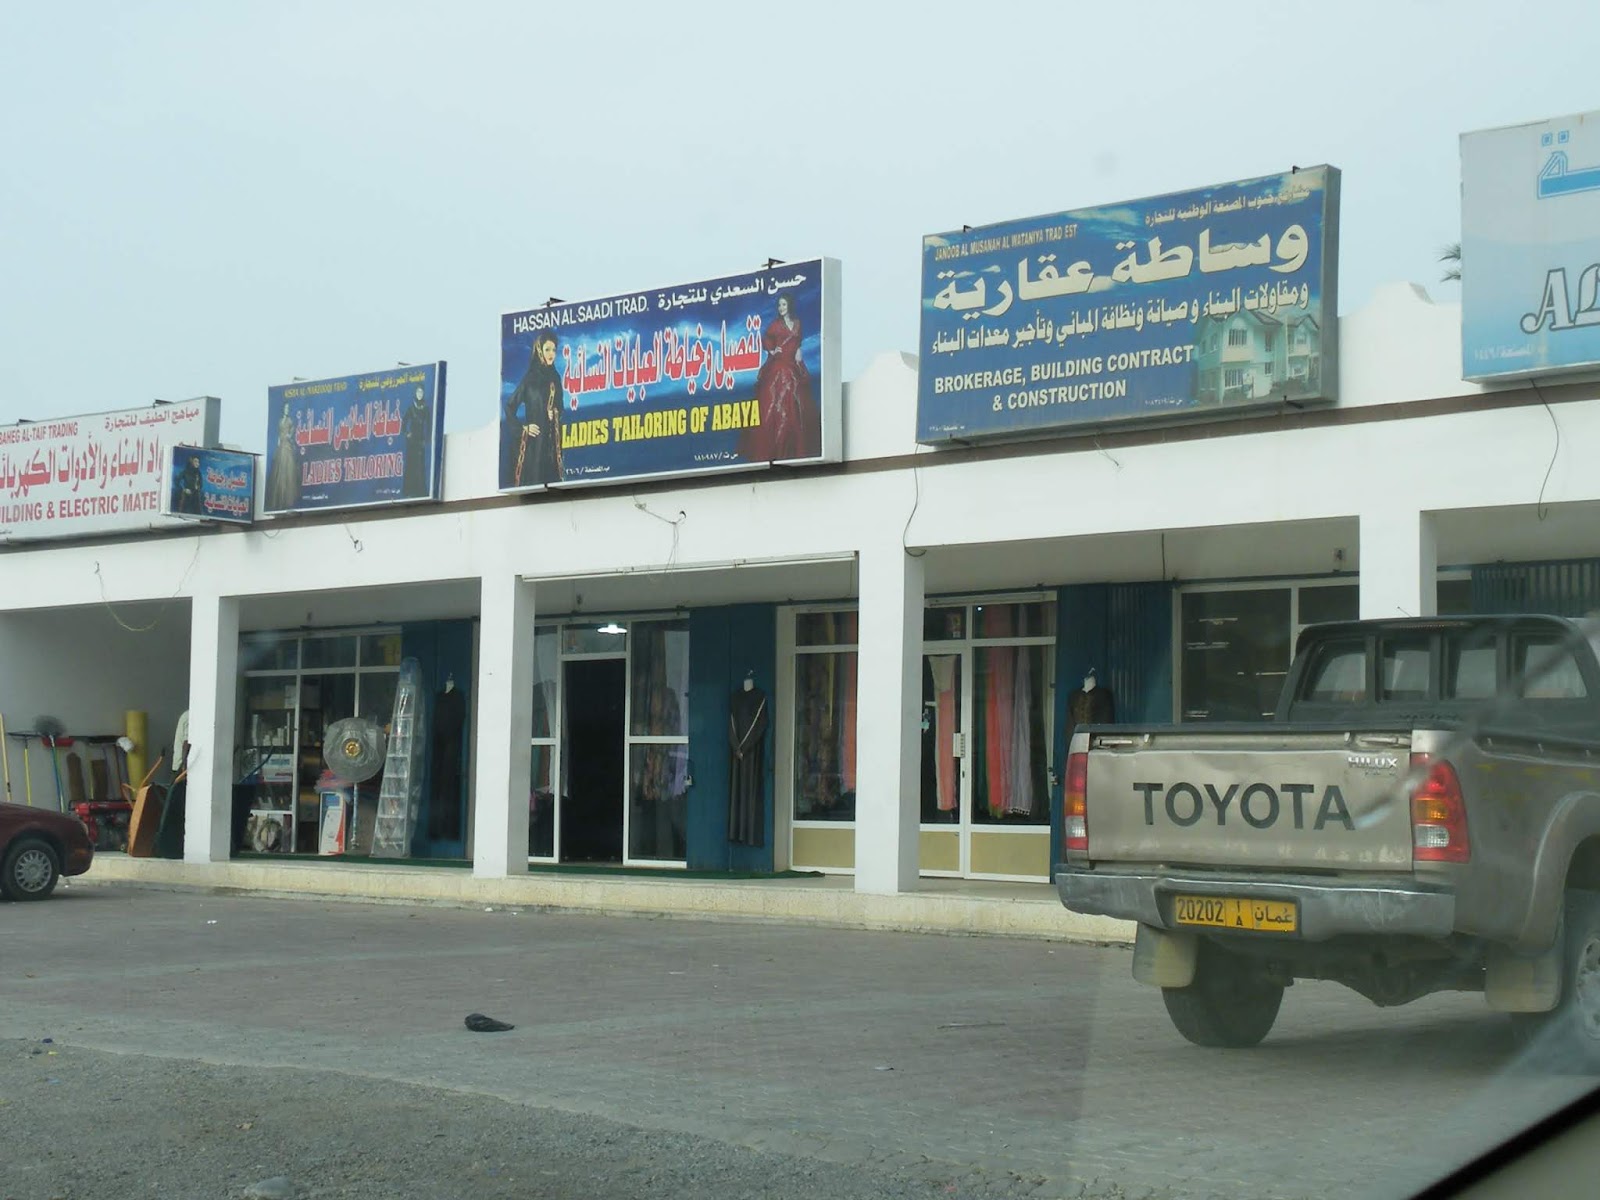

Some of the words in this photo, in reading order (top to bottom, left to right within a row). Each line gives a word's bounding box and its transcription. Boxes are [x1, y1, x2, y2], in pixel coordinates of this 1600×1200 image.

[960, 244, 969, 257] AL
[970, 236, 1001, 255] MUSANAH
[1001, 236, 1010, 249] AL
[1011, 228, 1044, 247] WATANIYA
[1045, 226, 1063, 241] TRAD
[1065, 223, 1078, 238] EST
[1111, 223, 1310, 285] وساطة
[657, 287, 708, 311] للتجارة
[710, 277, 765, 306] السعدي
[767, 274, 807, 295] حسن
[932, 253, 1095, 321] عقارية
[1244, 279, 1309, 314] ومقاولات
[513, 309, 560, 335] HASSAN
[615, 295, 650, 317] TRAD.
[1101, 302, 1144, 332] ونظافة
[1146, 298, 1188, 327] صيانة
[1202, 286, 1241, 320] البناء
[931, 325, 965, 357] البناء
[967, 324, 1010, 349] معدات
[1012, 309, 1053, 349] وتأجير
[1055, 307, 1100, 347] المباني
[612, 328, 664, 404] العبايات
[714, 314, 762, 391] تفصيل
[935, 366, 1026, 394] BROKERAGE,
[1031, 356, 1103, 382] BUILDING
[1107, 344, 1195, 373] CONTRACT
[562, 338, 612, 412] النسائية
[992, 394, 1003, 413] &
[1007, 379, 1127, 410] CONSTRUCTION
[48, 421, 79, 439] TRADING
[104, 413, 138, 433] للتجارة
[295, 406, 334, 456] النسائية
[333, 402, 373, 451] الملابس
[372, 399, 402, 446] خياطة
[561, 418, 610, 449] LADIES
[613, 408, 688, 443] TAILORING
[690, 405, 710, 434] OF
[712, 399, 762, 431] ABAYA
[111, 436, 145, 488] البناء
[302, 457, 342, 487] LADIES
[344, 451, 404, 483] TAILORING
[47, 501, 56, 519] &
[59, 494, 119, 519] ELECTRIC
[1348, 756, 1399, 769] HILUX
[1133, 781, 1356, 831] TOYOTA
[1178, 898, 1224, 923] 20202
